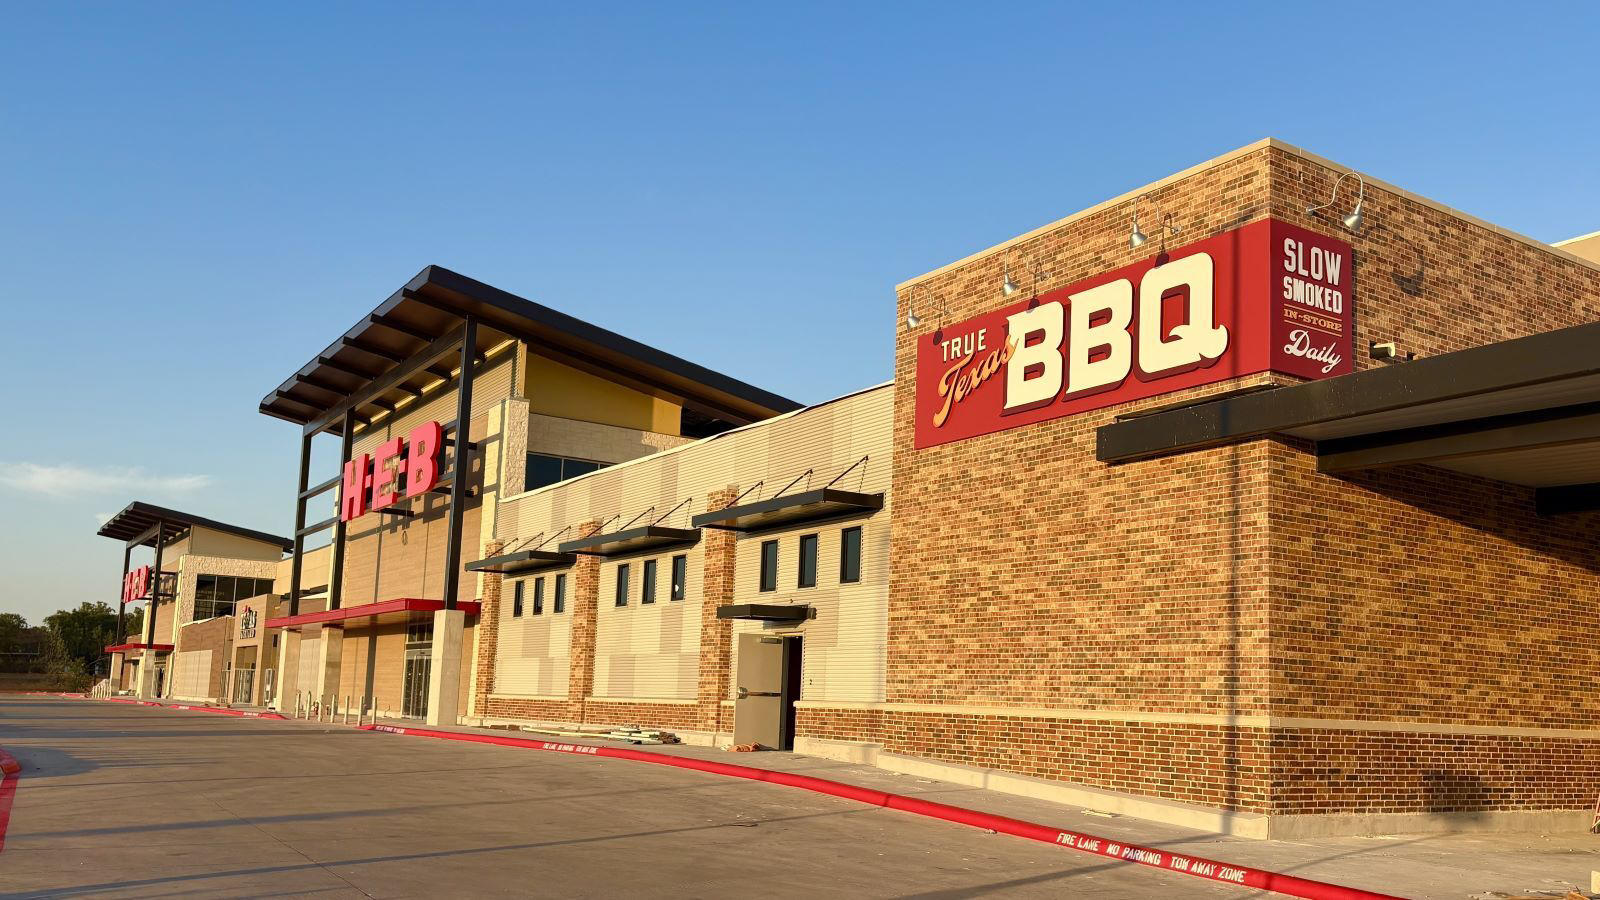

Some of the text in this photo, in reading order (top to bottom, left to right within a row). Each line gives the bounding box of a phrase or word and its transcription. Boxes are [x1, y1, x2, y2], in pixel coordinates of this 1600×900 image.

[1283, 237, 1342, 286] SLOW
[1283, 275, 1343, 314] SMOKED
[941, 328, 987, 362] TRUE
[1003, 252, 1229, 412] BBQ
[1283, 329, 1342, 374] Daily
[932, 334, 1020, 428] Texas
[1057, 832, 1247, 883] FIRE LANE NO PARKING TOW AWAY ZONE
